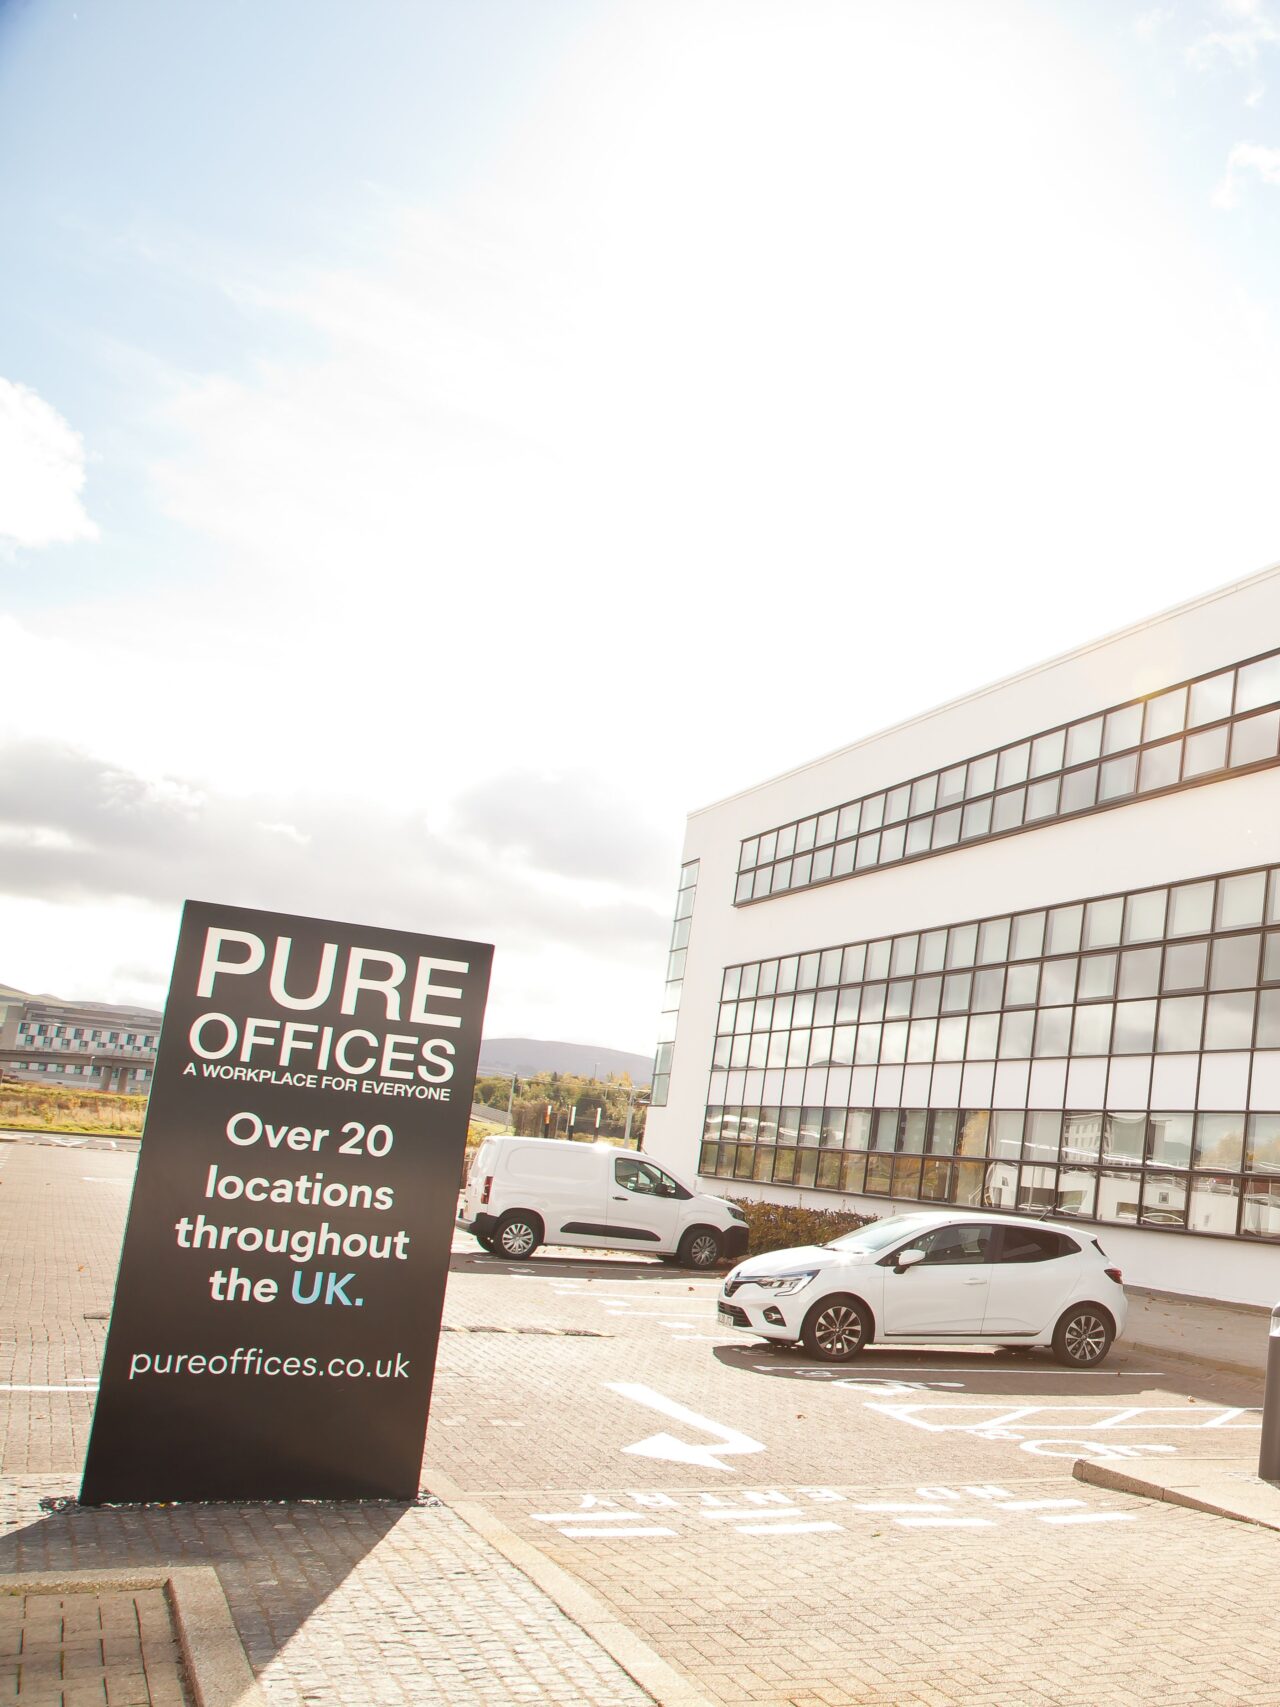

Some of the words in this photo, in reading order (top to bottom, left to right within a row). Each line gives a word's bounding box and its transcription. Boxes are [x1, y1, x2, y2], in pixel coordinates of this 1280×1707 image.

[195, 926, 470, 1029] PURE
[188, 1012, 456, 1084] OFFICES
[182, 1062, 198, 1076] A
[202, 1063, 318, 1088] WORKPLACE
[320, 1075, 358, 1092] FOR
[361, 1080, 452, 1102] EVERYONE
[225, 1111, 330, 1152] Over
[337, 1121, 395, 1158] 20
[203, 1164, 395, 1211] locations
[174, 1214, 411, 1263] throughout
[208, 1267, 279, 1303] the
[291, 1270, 365, 1307] UK.
[128, 1347, 411, 1380] pureoffices.co.uk
[578, 1488, 852, 1509] ENTRY
[914, 1485, 1016, 1500] NO
